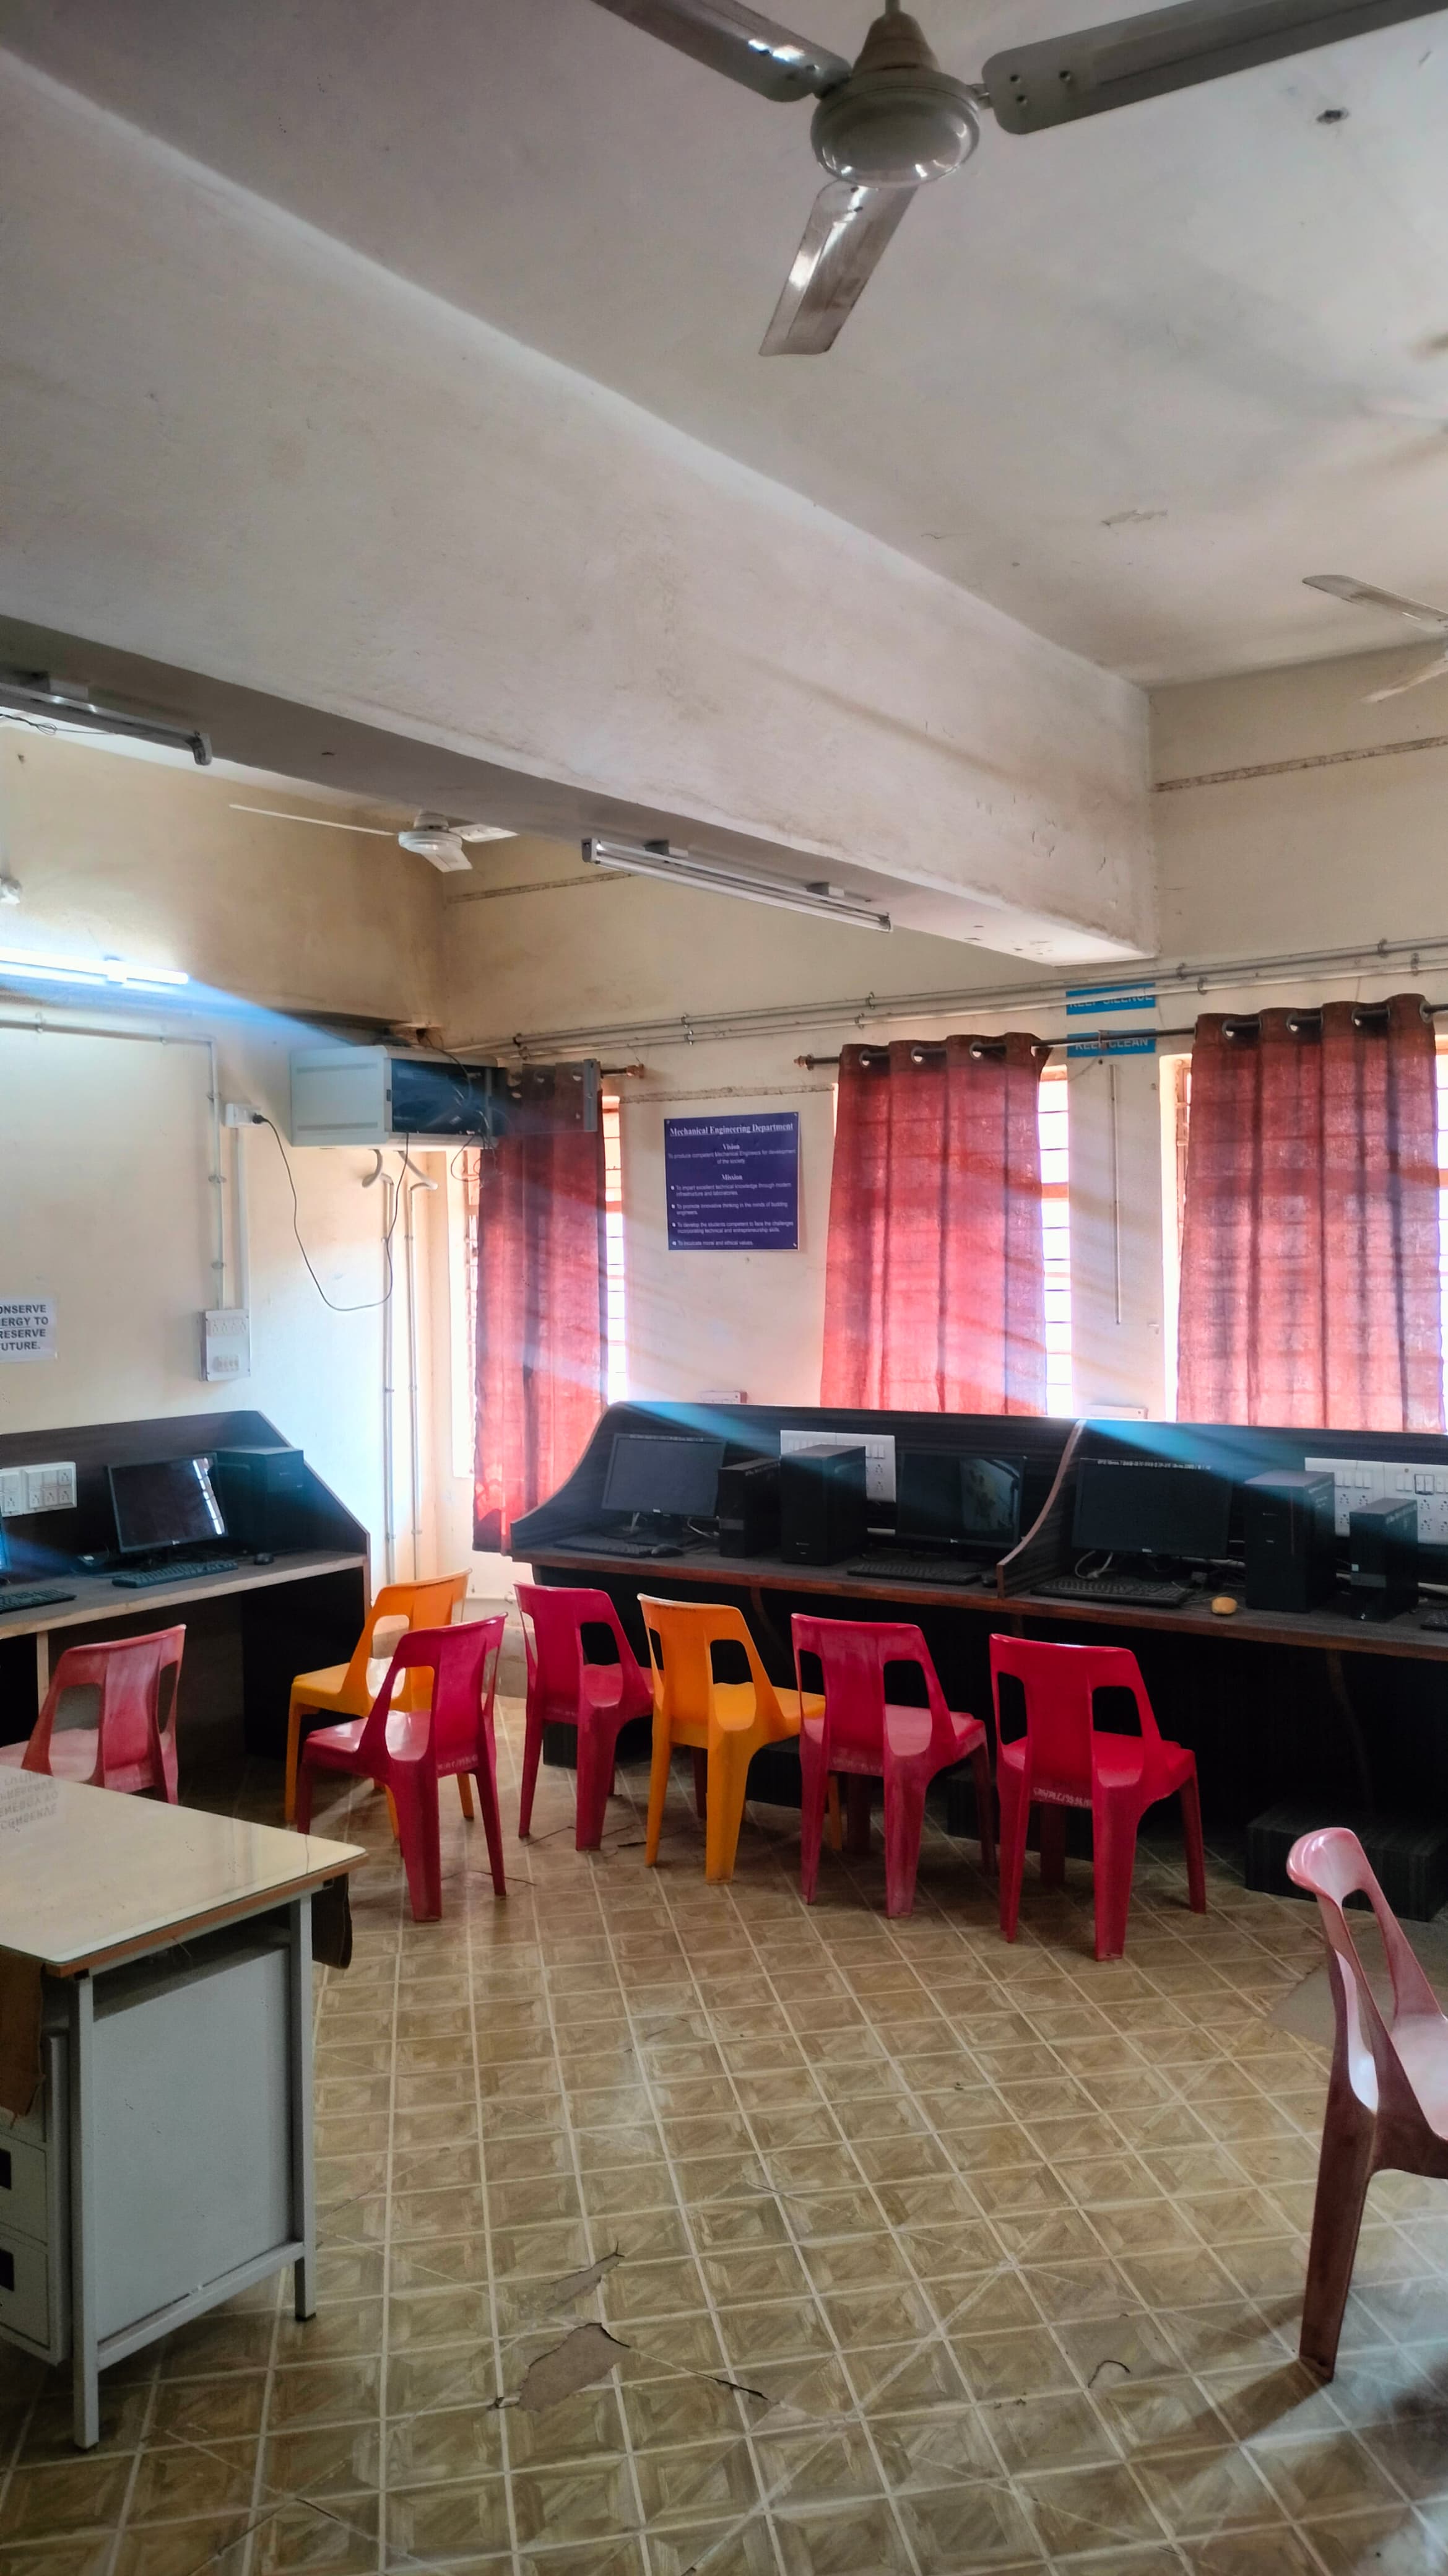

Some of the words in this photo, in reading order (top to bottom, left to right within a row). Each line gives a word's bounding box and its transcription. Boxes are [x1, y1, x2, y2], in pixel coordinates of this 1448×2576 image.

[1109, 1039, 1148, 1048] CLEAN
[670, 1126, 708, 1136] Mechanical
[710, 1124, 750, 1135] Engineering
[752, 1123, 793, 1133] Department
[0, 1317, 30, 1326] ERGY
[34, 1316, 48, 1325] TO
[0, 1341, 40, 1351] UTURE.
